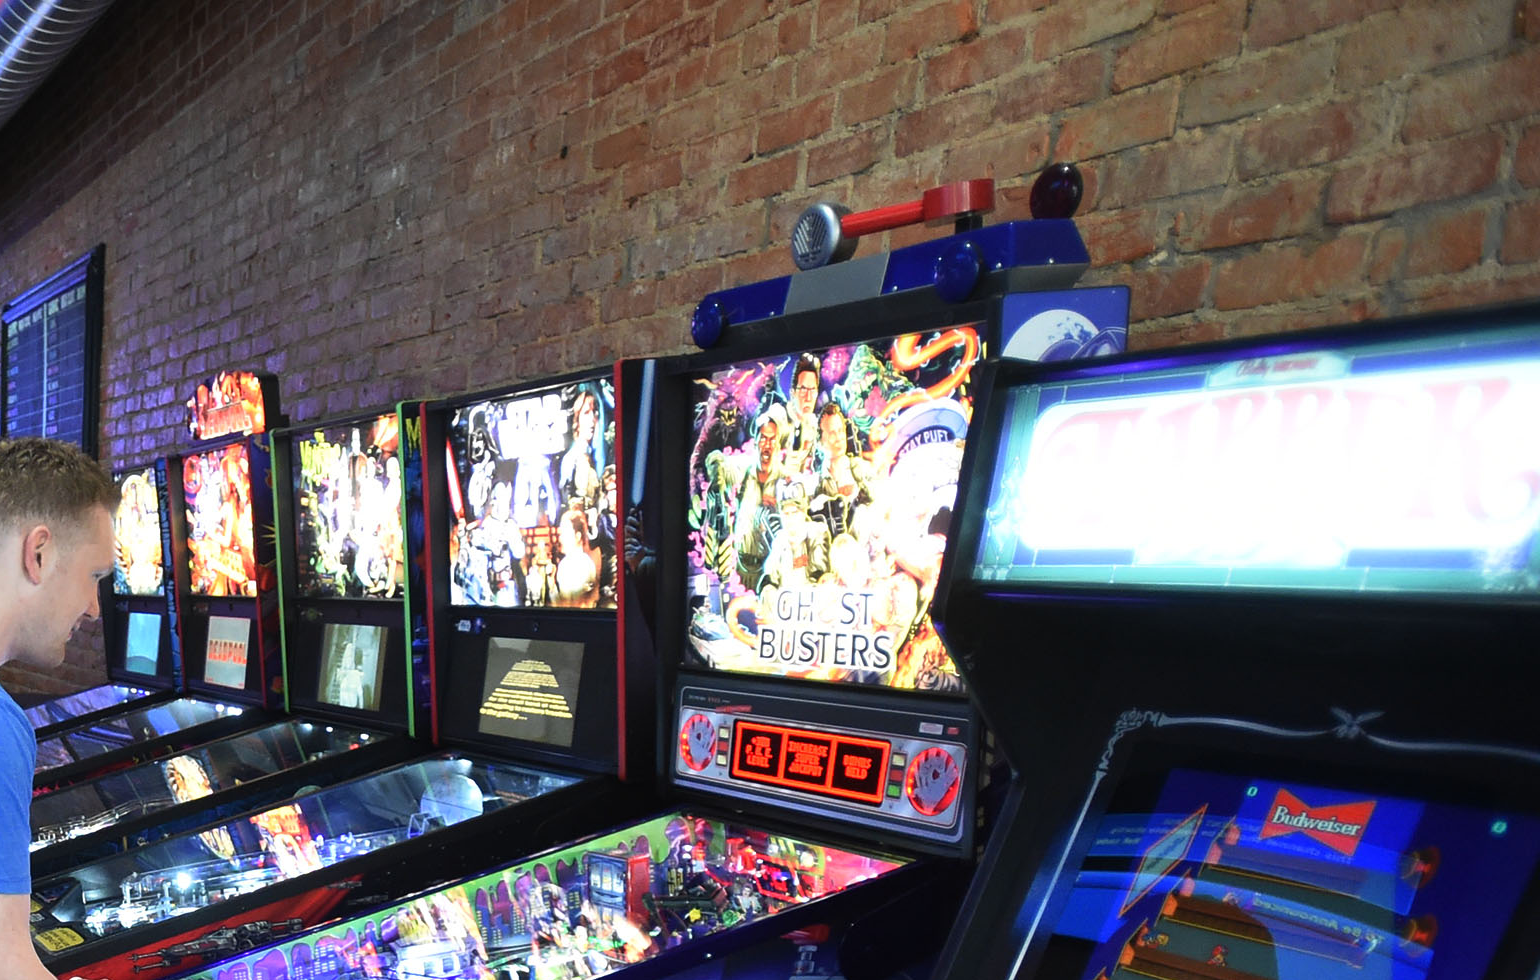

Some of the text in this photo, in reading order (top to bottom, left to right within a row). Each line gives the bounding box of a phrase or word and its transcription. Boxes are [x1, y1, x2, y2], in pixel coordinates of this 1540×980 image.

[923, 429, 949, 444] PUFT
[776, 590, 874, 626] GHST
[759, 628, 891, 669] BUSTERS
[1271, 805, 1361, 835] Budweiser
